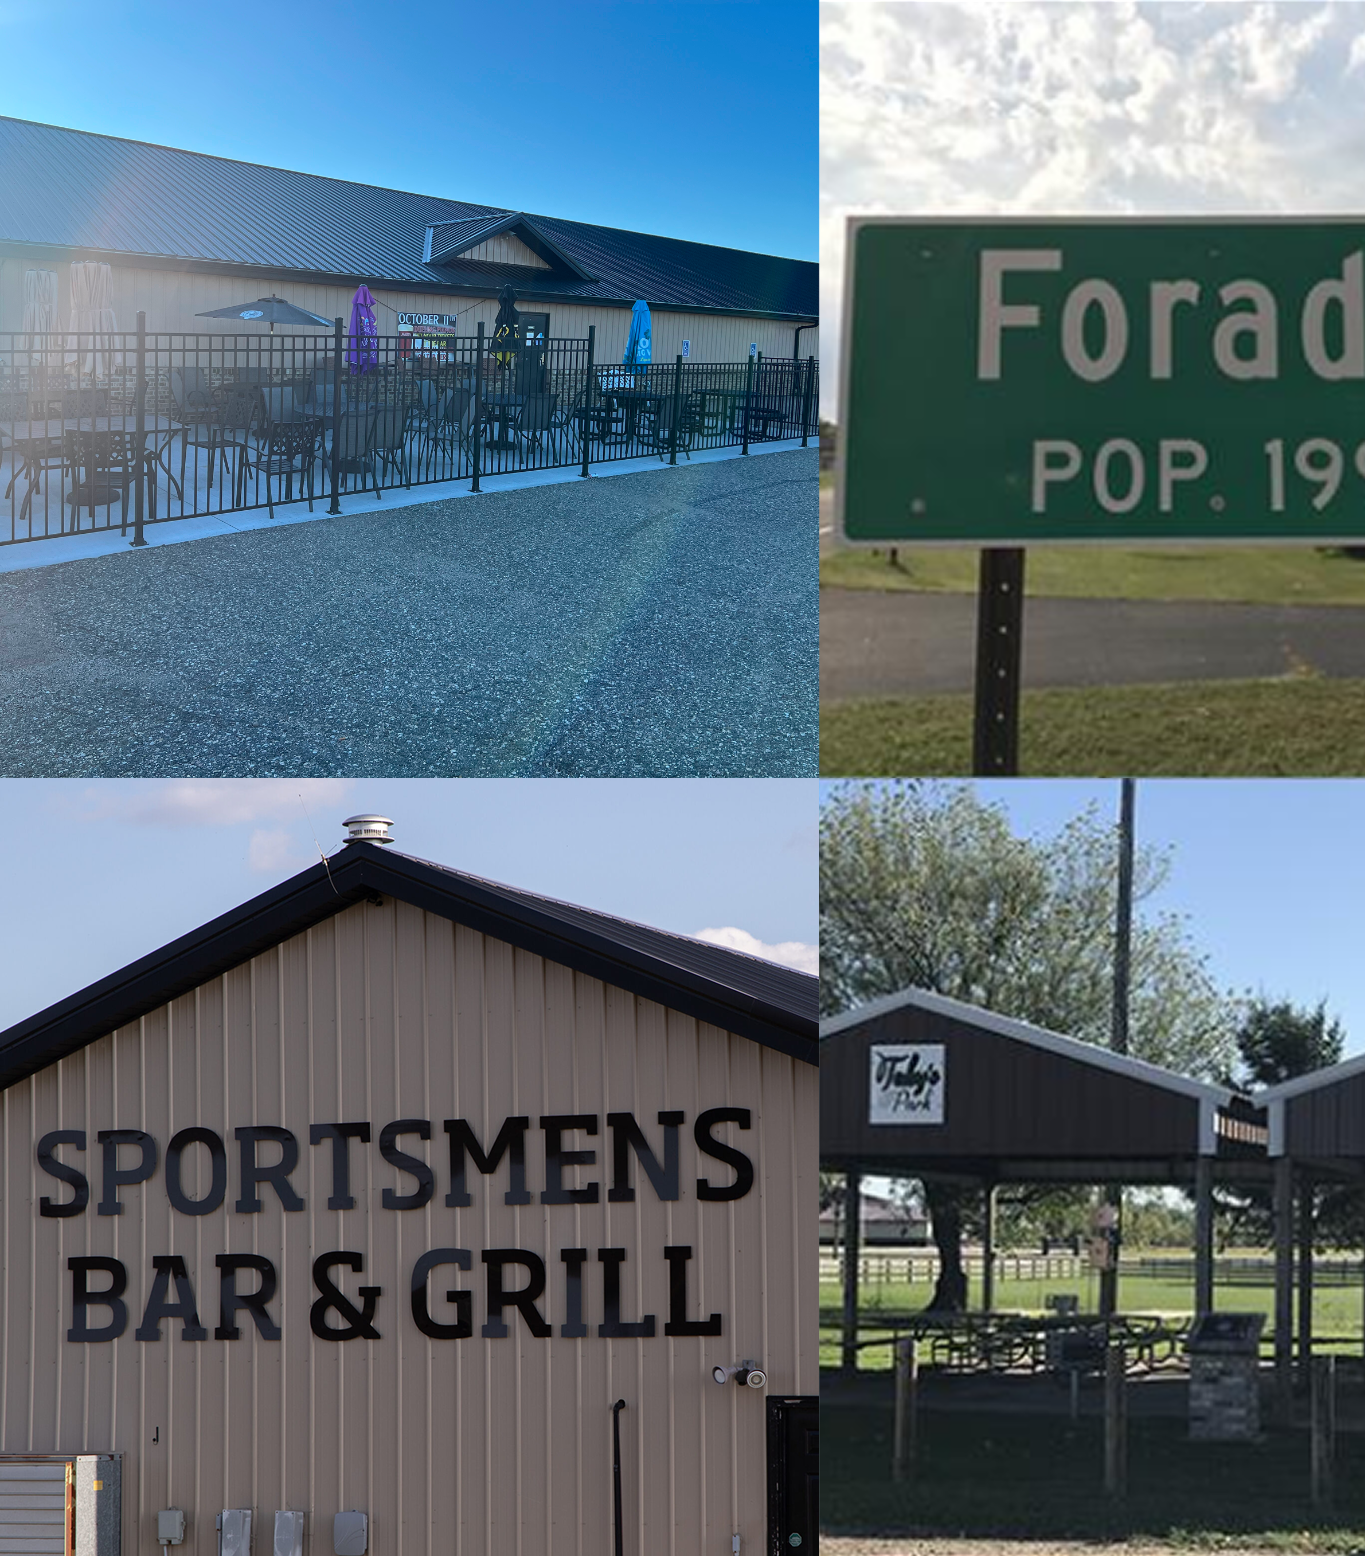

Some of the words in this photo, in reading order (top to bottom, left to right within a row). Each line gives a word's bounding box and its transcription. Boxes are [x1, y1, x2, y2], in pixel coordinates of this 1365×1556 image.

[398, 312, 439, 325] OCTOBER
[1031, 437, 1227, 513] POP.
[892, 1088, 932, 1112] Park
[37, 1107, 755, 1218] SPORTSMENS
[66, 1253, 282, 1343] BAR
[309, 1250, 382, 1340] &
[410, 1246, 722, 1339] GRILL
